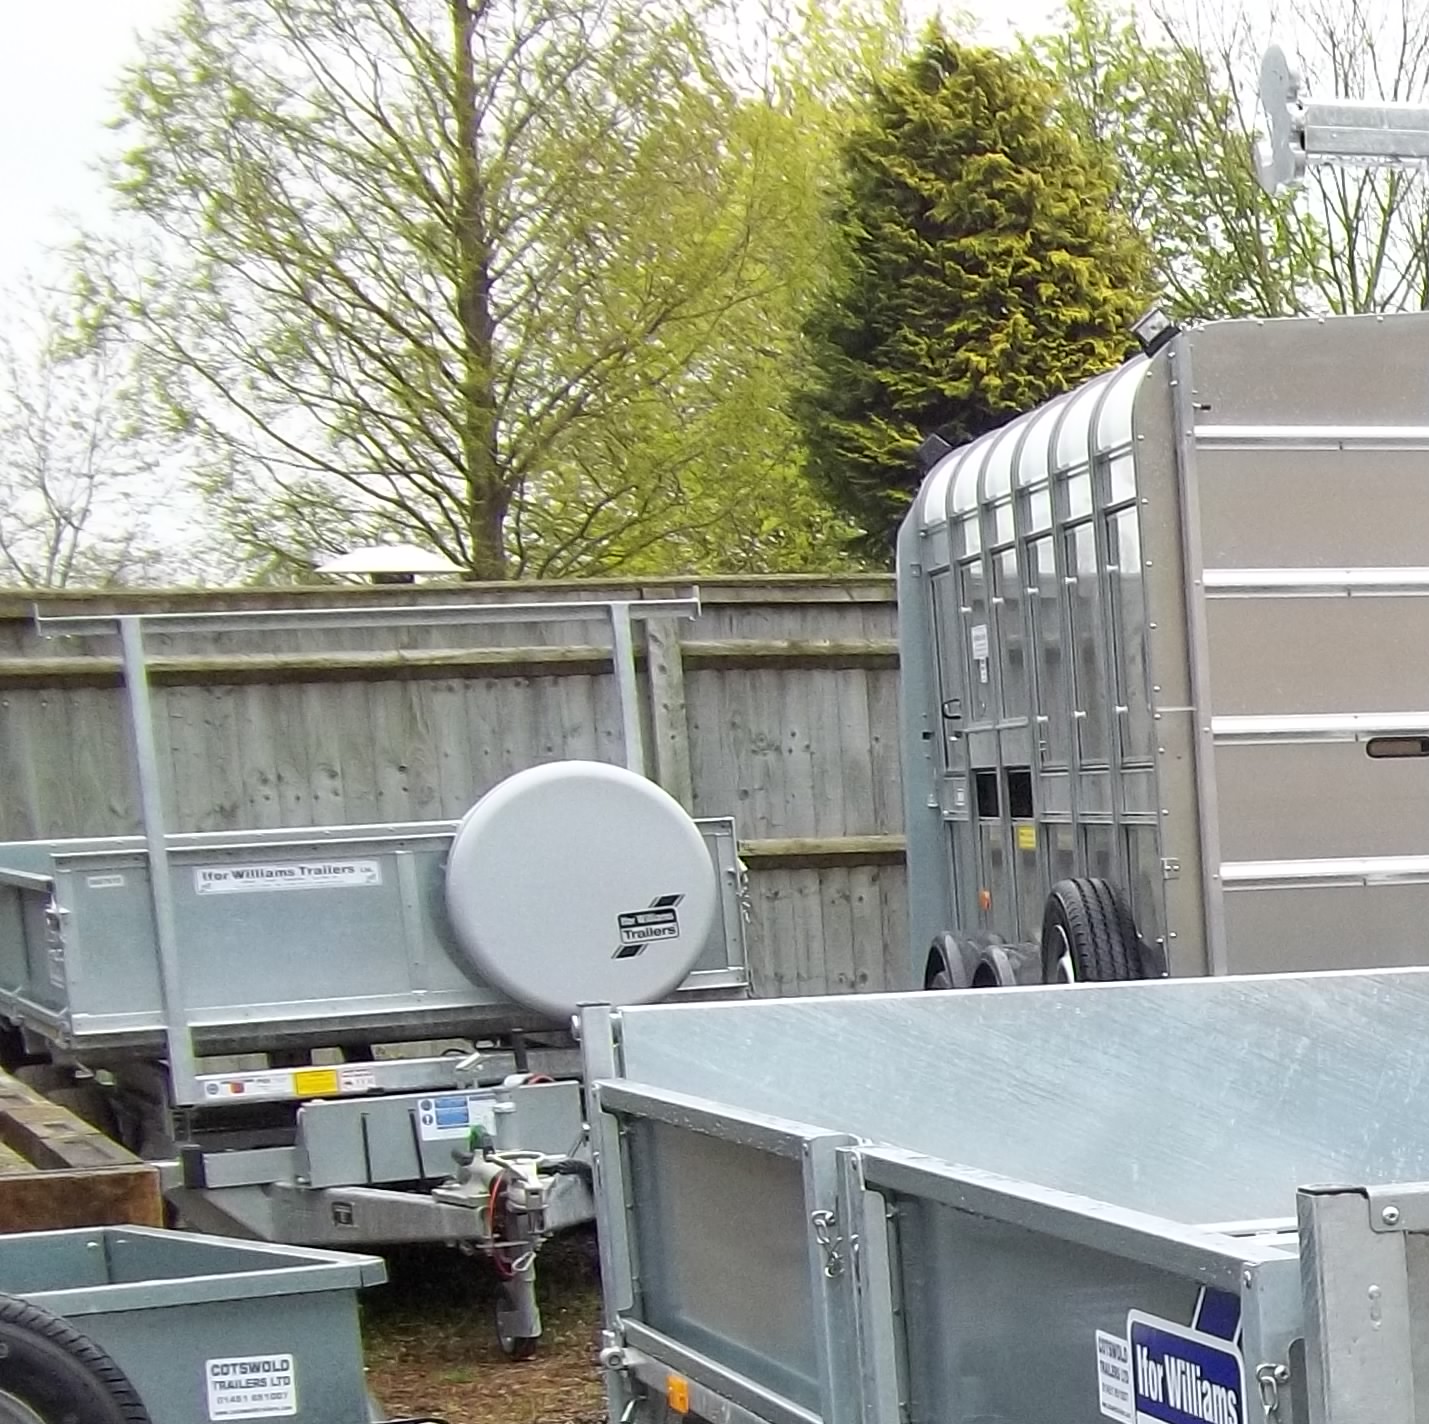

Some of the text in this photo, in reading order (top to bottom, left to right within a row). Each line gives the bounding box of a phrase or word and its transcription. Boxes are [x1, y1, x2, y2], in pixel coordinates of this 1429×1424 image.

[202, 871, 228, 881] Ifor
[231, 867, 295, 880] Williams
[298, 864, 355, 876] Trailers
[623, 926, 676, 940] Trailers
[211, 1359, 290, 1377] COTSWOLD
[1136, 1343, 1163, 1403] Ifor
[212, 1376, 291, 1390] TRAILERS LTD
